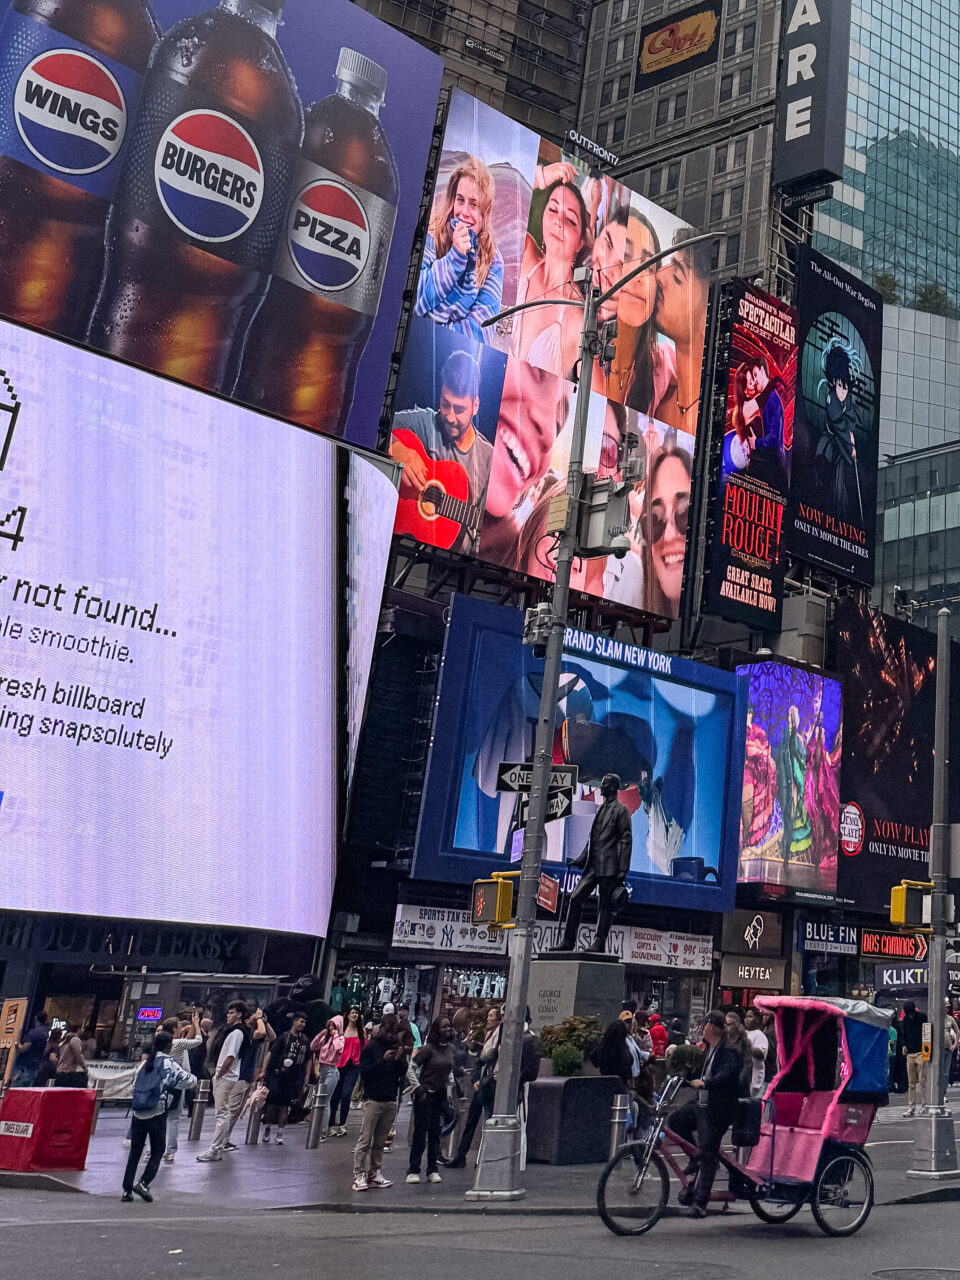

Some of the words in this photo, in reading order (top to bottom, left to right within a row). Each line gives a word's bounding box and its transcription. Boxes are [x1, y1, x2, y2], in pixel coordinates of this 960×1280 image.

[24, 80, 119, 142] WINGS
[161, 141, 257, 208] BURGERS
[293, 210, 362, 261] PIZZA
[810, 260, 822, 275] The
[822, 269, 844, 289] All-Out
[845, 283, 857, 298] War
[744, 291, 778, 316] BROADWAY'S
[738, 298, 796, 345] SPECTACULAR
[742, 319, 772, 340] NIGHT
[723, 482, 776, 530] MOULIN
[798, 502, 824, 525] NOW
[825, 514, 867, 545] PLAYING
[794, 519, 812, 534] ONLY
[811, 526, 819, 537] IN
[819, 529, 840, 547] MOVIE
[839, 538, 869, 559] THEATRES
[726, 565, 750, 587] GREAT
[750, 573, 773, 594] SEATS
[12, 578, 67, 612] not
[73, 585, 177, 638] found...
[720, 580, 758, 607] AVAILABLE
[758, 592, 777, 613] NOW!
[29, 626, 134, 664] smoothie.
[595, 636, 623, 661] SLAM
[624, 643, 647, 667] NEW
[647, 649, 673, 674] YORK
[52, 681, 146, 720] billboard
[0, 704, 34, 738] ing
[39, 717, 173, 760] snapsolutely
[509, 771, 532, 784] ONE
[550, 774, 567, 785] AY
[873, 818, 902, 840] NOW
[904, 826, 931, 848] PLAY
[868, 840, 889, 856] ONLY
[888, 843, 897, 857] IN
[897, 844, 920, 862] MOVIE
[418, 907, 446, 921] SPORTS
[446, 910, 461, 922] FAN
[461, 912, 471, 924] SH
[634, 931, 663, 942] DISCOUNT
[636, 941, 651, 951] GIFTS
[806, 922, 834, 942] BLUE
[838, 926, 858, 944] FIN
[862, 933, 879, 953] DOS
[631, 950, 663, 962] SOUVENIRS
[459, 974, 507, 999] GRAN
[738, 966, 771, 980] HEYTEA
[883, 968, 930, 985] KLIKTI
[538, 989, 562, 999] GEORGE
[51, 1018, 67, 1030] live
[139, 1010, 160, 1019] OPEN
